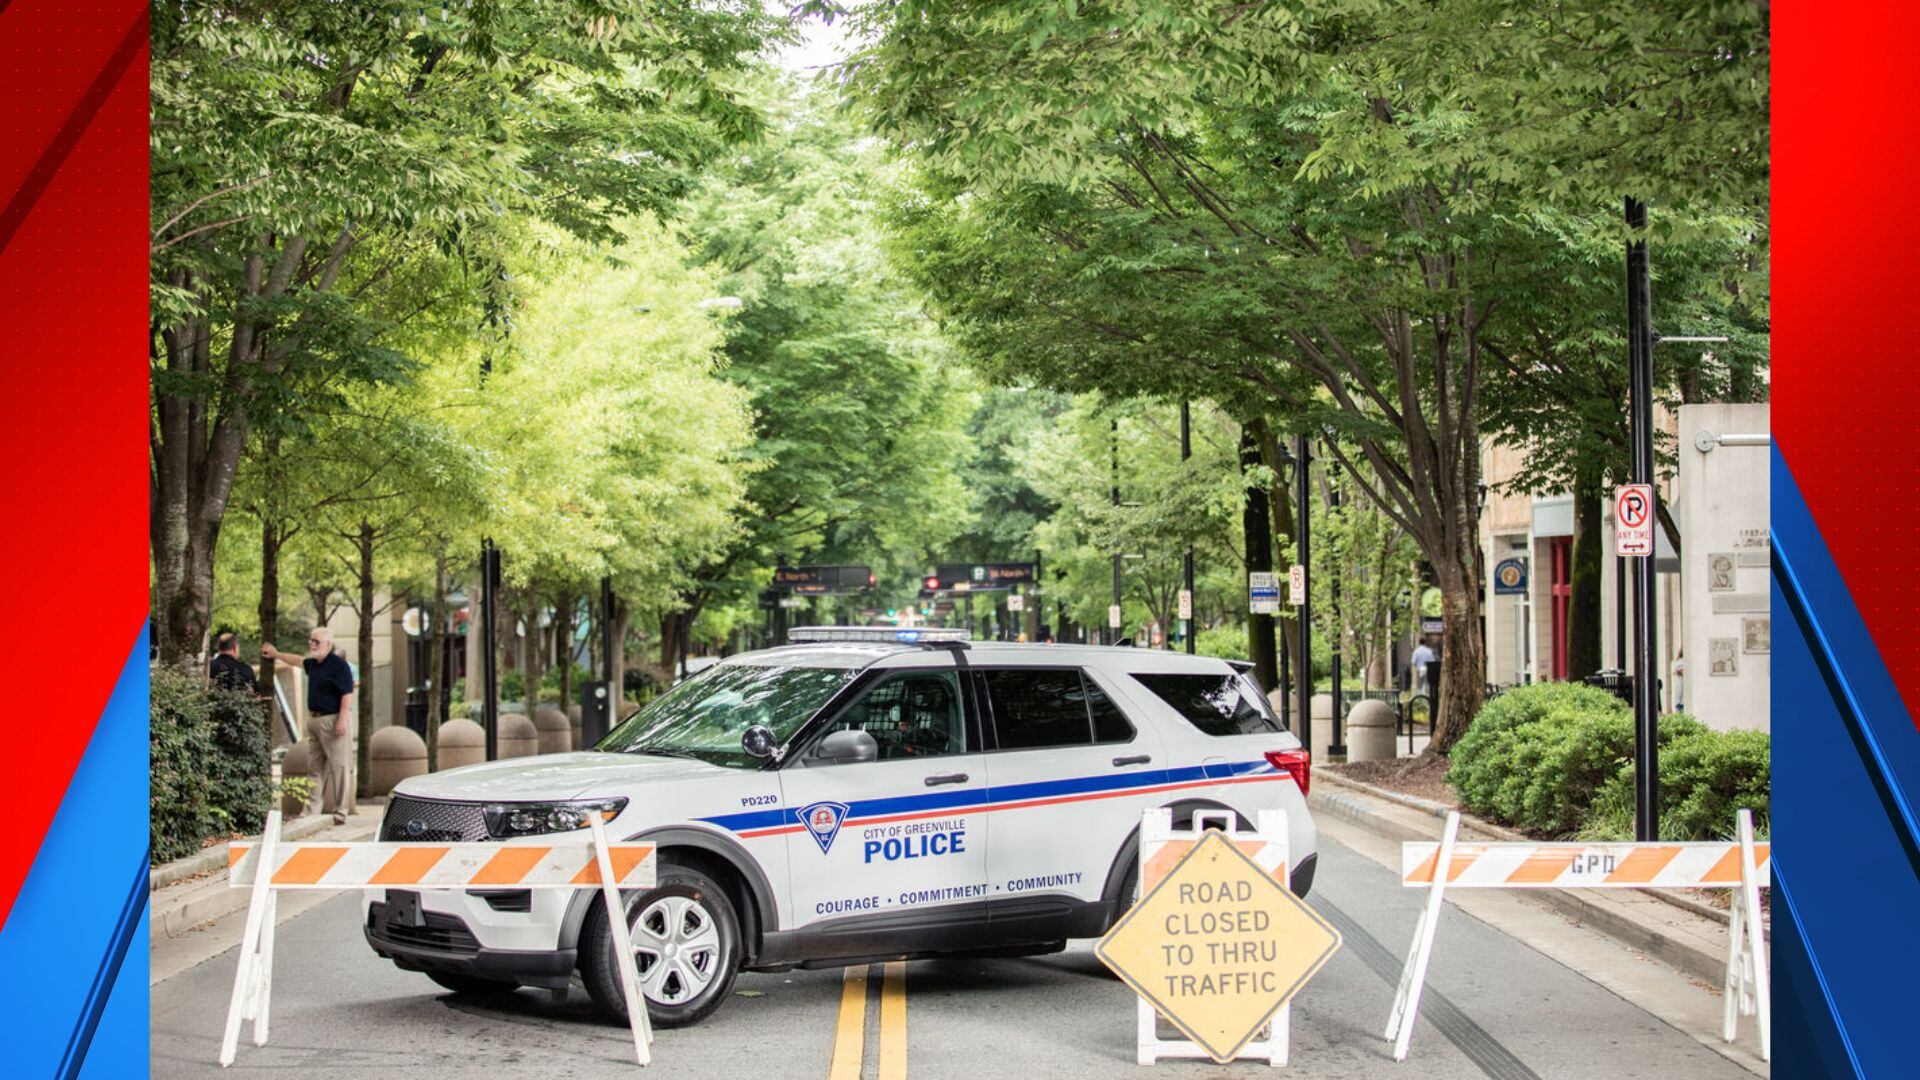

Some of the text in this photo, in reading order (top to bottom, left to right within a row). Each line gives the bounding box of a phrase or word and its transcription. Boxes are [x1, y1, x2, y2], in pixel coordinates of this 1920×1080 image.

[1618, 531, 1649, 539] ANY TIME
[741, 794, 777, 807] PD220
[863, 819, 965, 840] CITY OF GREENVILLE
[864, 831, 966, 864] POLICE
[1572, 855, 1615, 874] GPD
[816, 872, 1083, 915] COURAGE COMMITMENT COMMUNITY
[1179, 881, 1253, 904] ROAD
[1165, 910, 1270, 935] CLOSED
[1161, 940, 1277, 966] TO THRU
[1164, 971, 1277, 997] TRAFFIC
